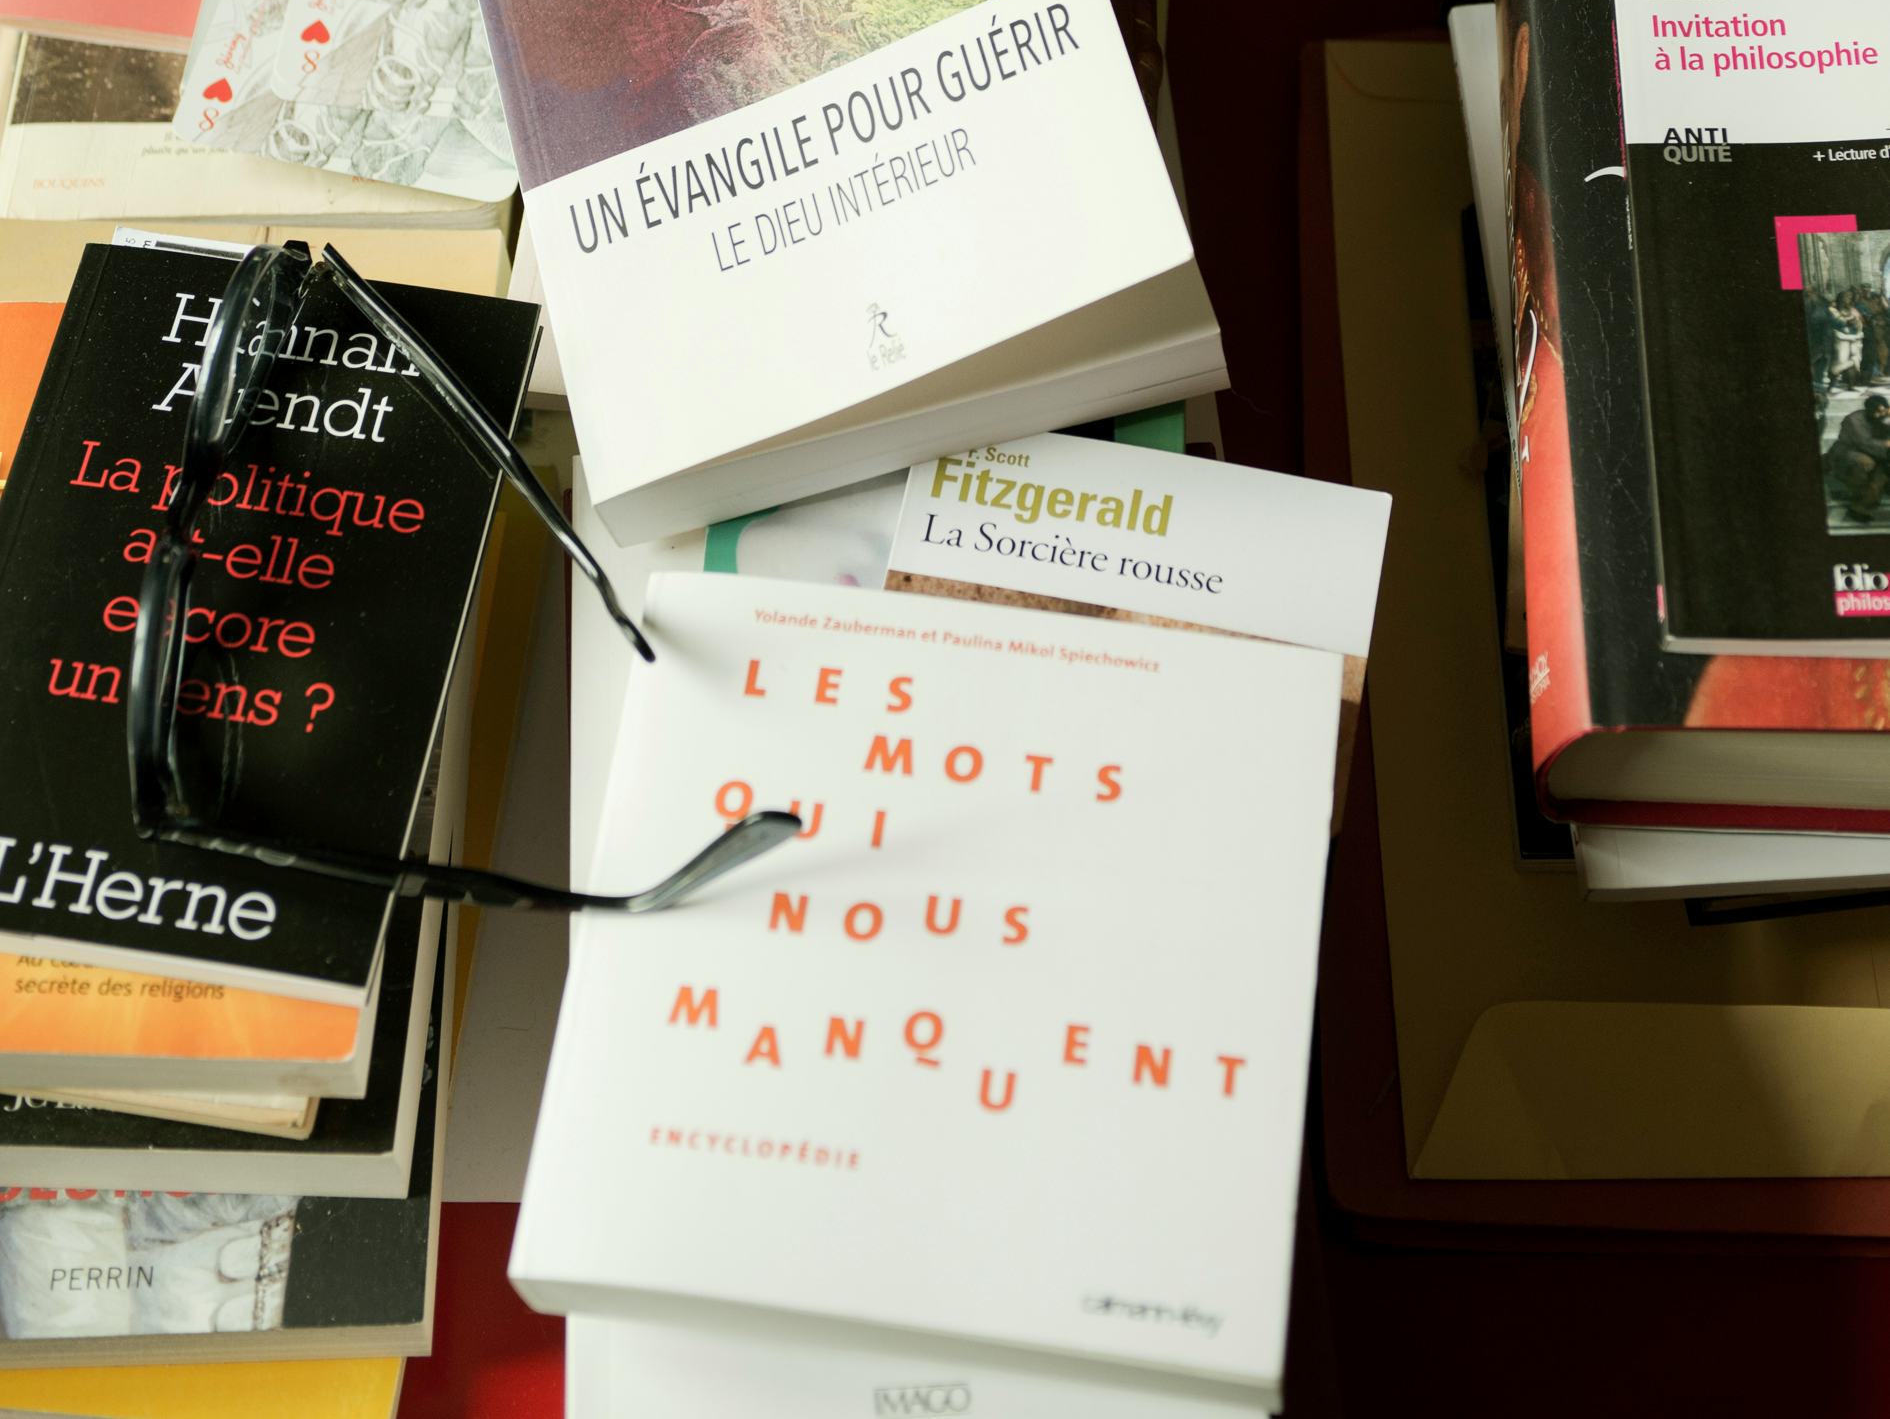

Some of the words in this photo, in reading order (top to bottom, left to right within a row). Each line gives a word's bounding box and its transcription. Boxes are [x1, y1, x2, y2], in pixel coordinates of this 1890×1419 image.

[1652, 13, 1787, 37] Invitation
[1654, 47, 1671, 70] à
[1680, 46, 1704, 70] la
[1713, 41, 1878, 77] philosophie
[569, 188, 630, 254] UN
[636, 115, 819, 230] ÉVANGILE
[822, 67, 932, 156] POUR
[936, 3, 1080, 103] GUÉRIR
[1663, 143, 1732, 164] QUITÉ
[1664, 127, 1728, 144] ANTI
[1828, 148, 1877, 161] Lecture
[711, 222, 751, 272] LE
[755, 193, 824, 256] DIEU
[828, 128, 977, 226] INTÉRIEUR
[152, 362, 394, 443] Aendt
[70, 440, 142, 494] La
[151, 464, 425, 536] politique
[985, 446, 1031, 468] Scott
[930, 456, 1174, 537] Fitzgerald
[123, 526, 335, 589] a-elle
[920, 513, 963, 548] La
[974, 521, 1108, 572] Sorcière
[1117, 556, 1223, 594] rousse
[1833, 563, 1889, 592] folio
[103, 594, 316, 659] ecore
[754, 609, 818, 629] Yolande
[822, 617, 917, 640] Zauberman
[921, 630, 938, 644] et
[943, 630, 1003, 653] Paulina
[1009, 640, 1055, 659] Mikol
[1059, 647, 1161, 674] Spiechowicz
[47, 658, 122, 704] un
[172, 678, 282, 728] ens
[743, 658, 914, 714] LES
[863, 734, 1123, 803] MOTS
[714, 780, 887, 849] QUI
[0, 836, 277, 941] L'Herne
[767, 891, 1030, 946] NOUS
[14, 977, 91, 996] secrète
[97, 977, 133, 998] des
[140, 979, 226, 1003] religions
[667, 985, 1247, 1112] MANQUENT
[650, 1126, 861, 1170] ENCYCLOPÉDIE
[50, 1264, 154, 1292] PERRIN
[873, 1384, 972, 1416] IMAGO
